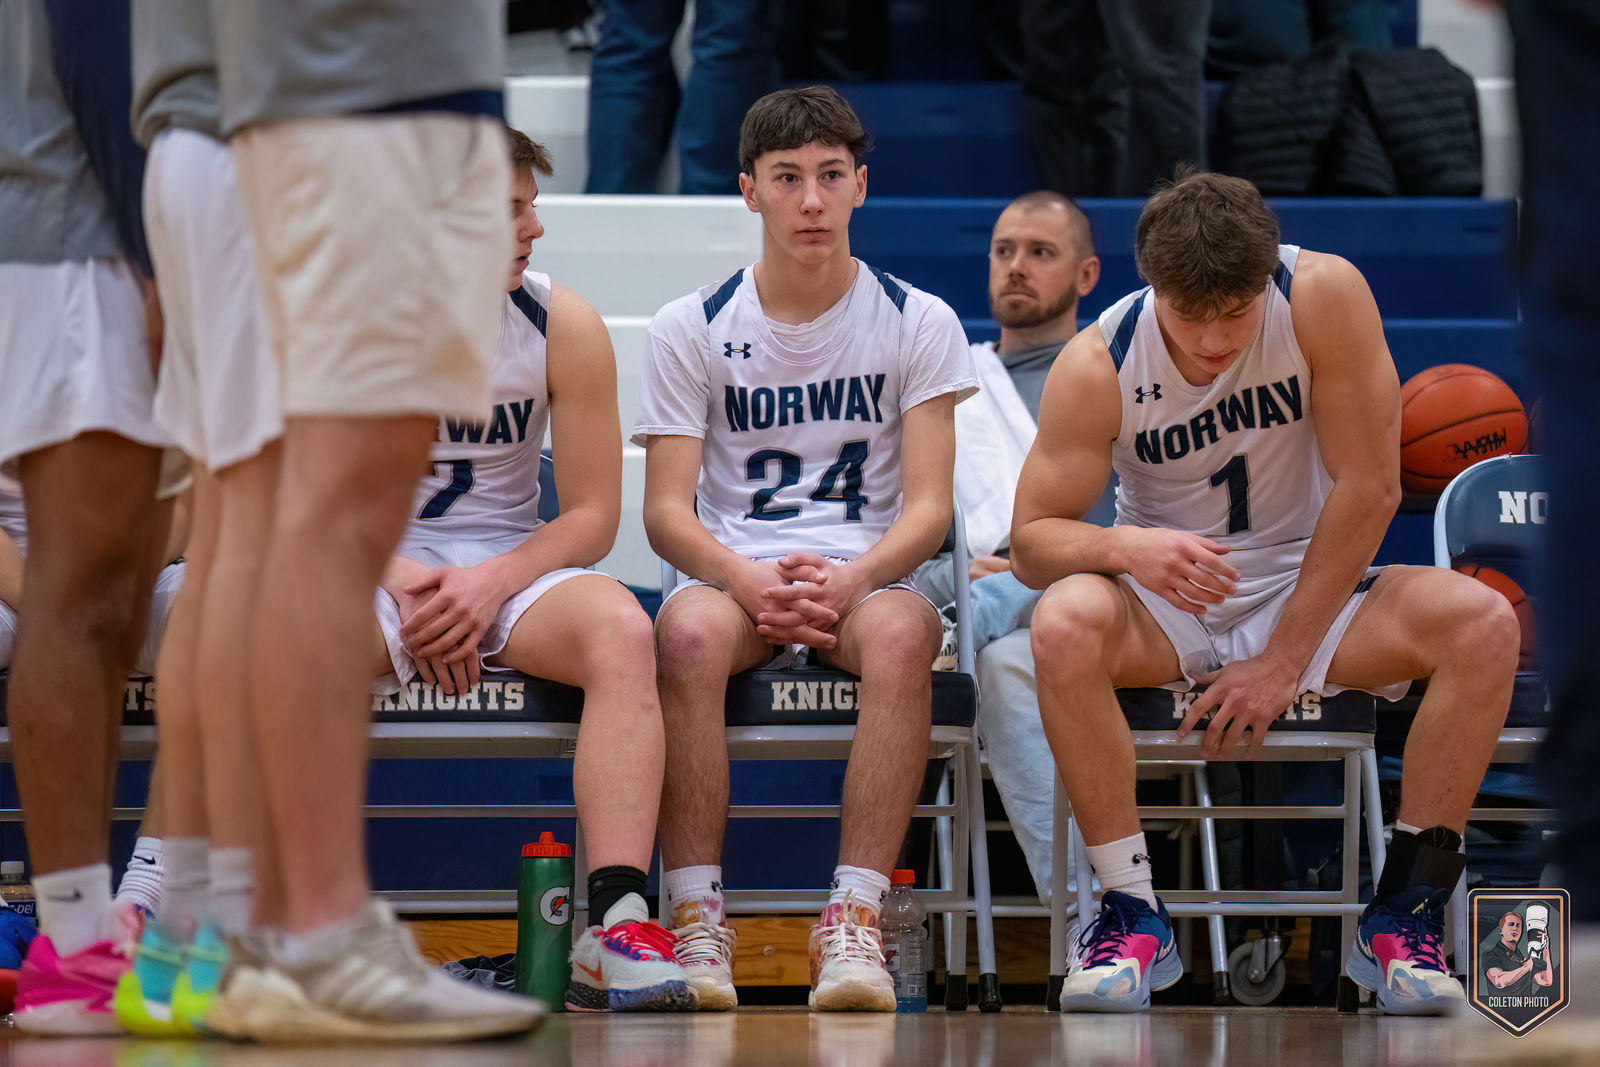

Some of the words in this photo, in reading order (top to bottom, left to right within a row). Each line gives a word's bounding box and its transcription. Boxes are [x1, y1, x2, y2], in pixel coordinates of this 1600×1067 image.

[440, 398, 535, 444] WAY
[724, 373, 886, 433] NORWAY
[1134, 374, 1303, 464] NORWAY
[744, 438, 871, 522] 24
[1209, 452, 1251, 536] 1
[771, 681, 863, 711] KNIG
